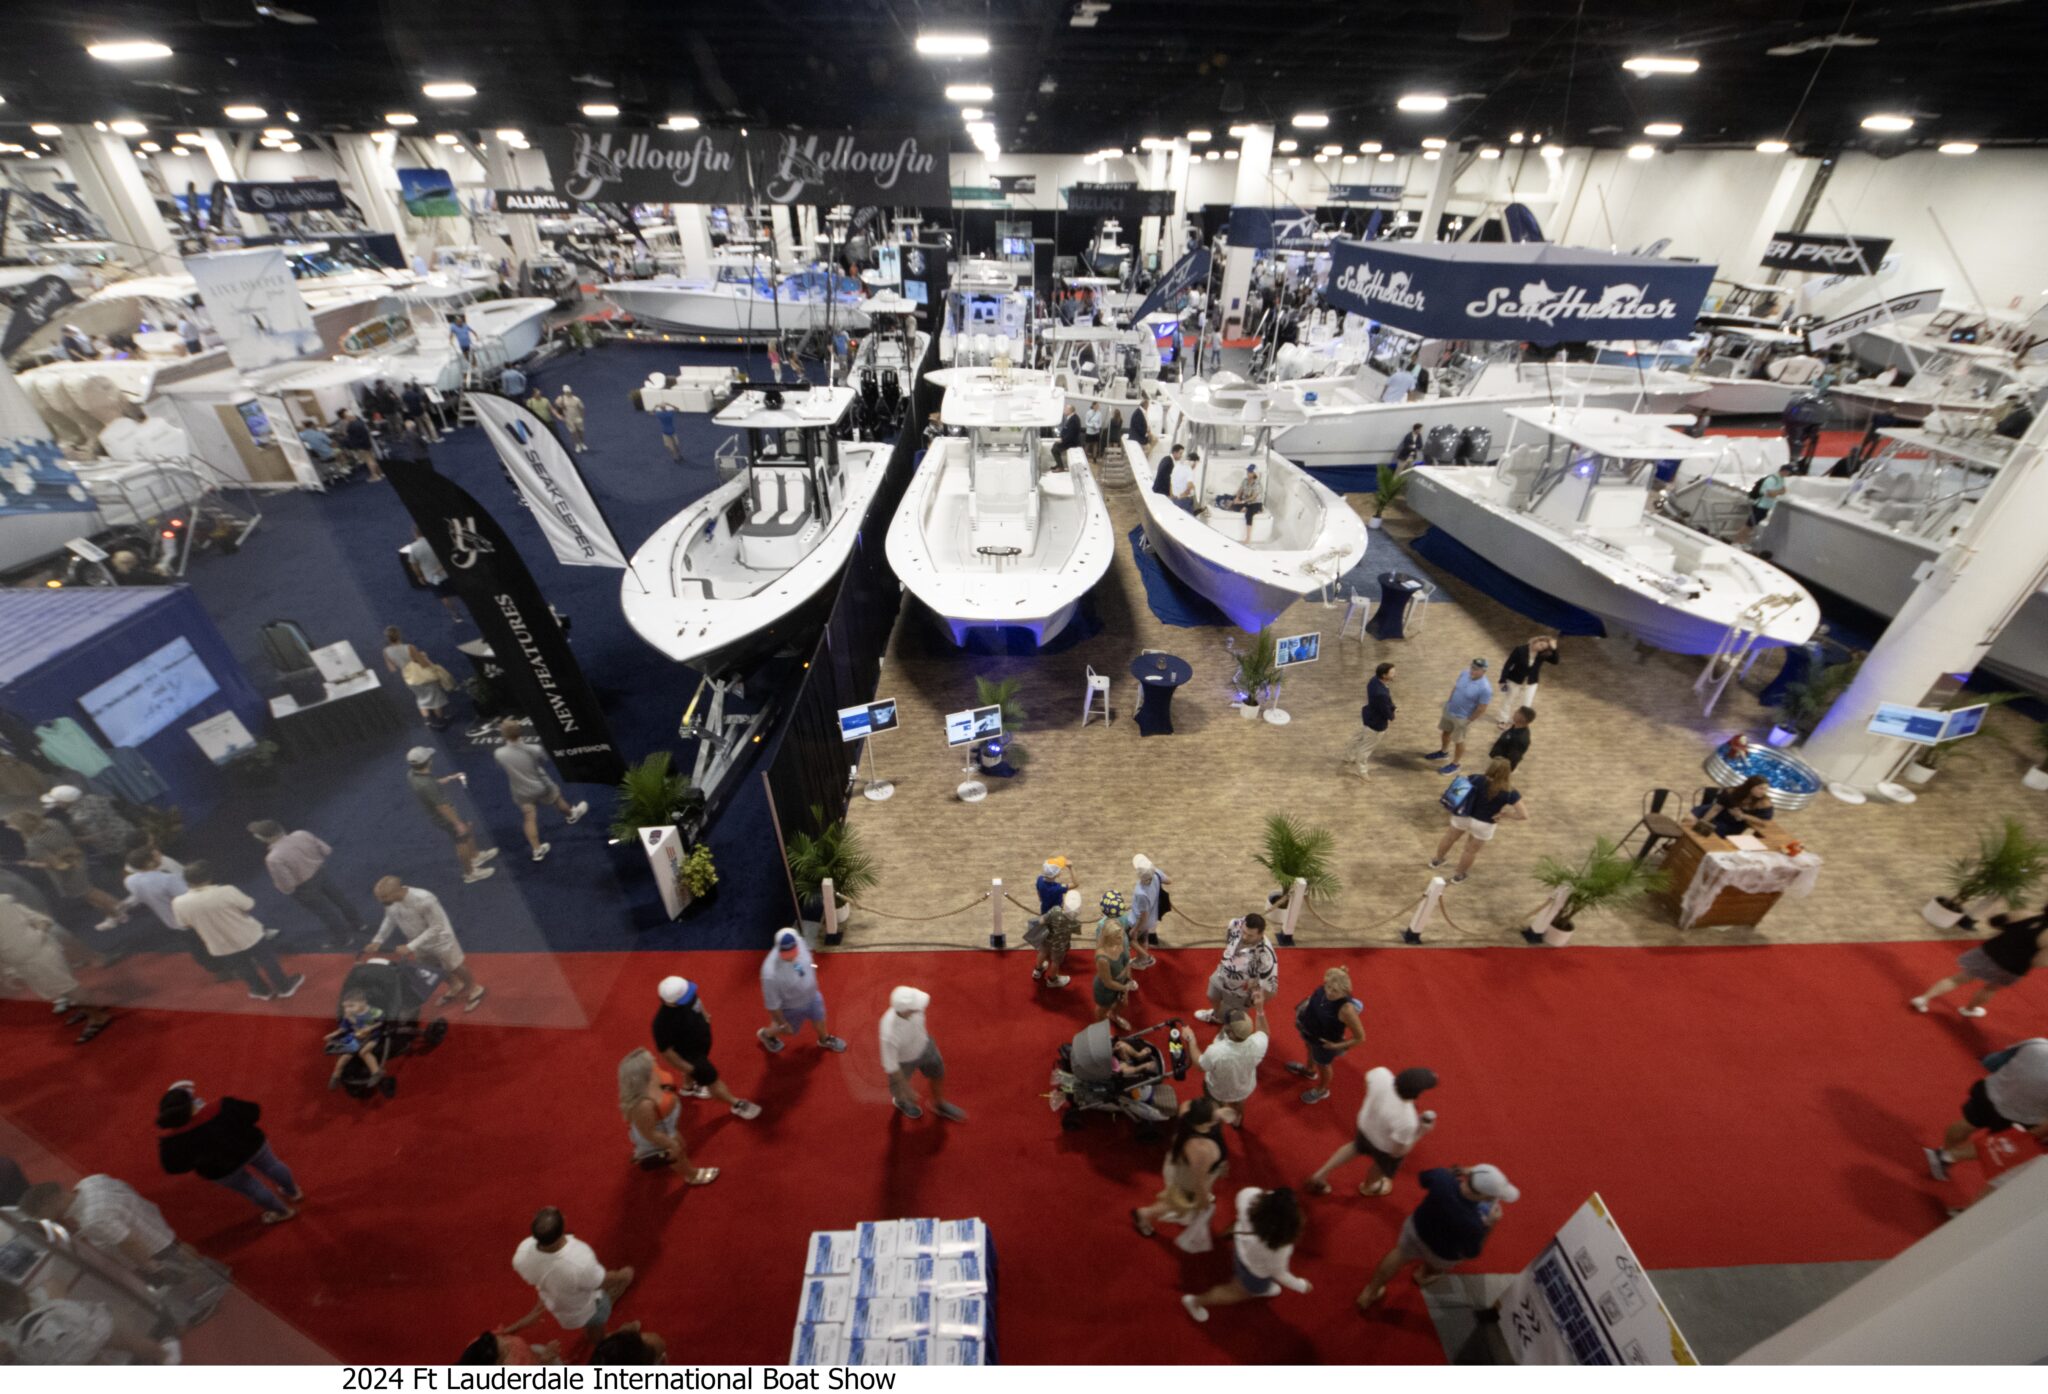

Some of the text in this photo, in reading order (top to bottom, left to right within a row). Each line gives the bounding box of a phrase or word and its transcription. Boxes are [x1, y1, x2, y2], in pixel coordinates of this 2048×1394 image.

[565, 130, 734, 200] Yellowfin
[766, 132, 937, 203] Yellowfin
[1790, 243, 1864, 264] PRO
[1465, 279, 1677, 327] SeaHunter
[1824, 315, 1869, 339] SEA
[525, 449, 595, 559] SEAKEEPER
[494, 593, 557, 690] FEATURES
[546, 692, 580, 733] NEW
